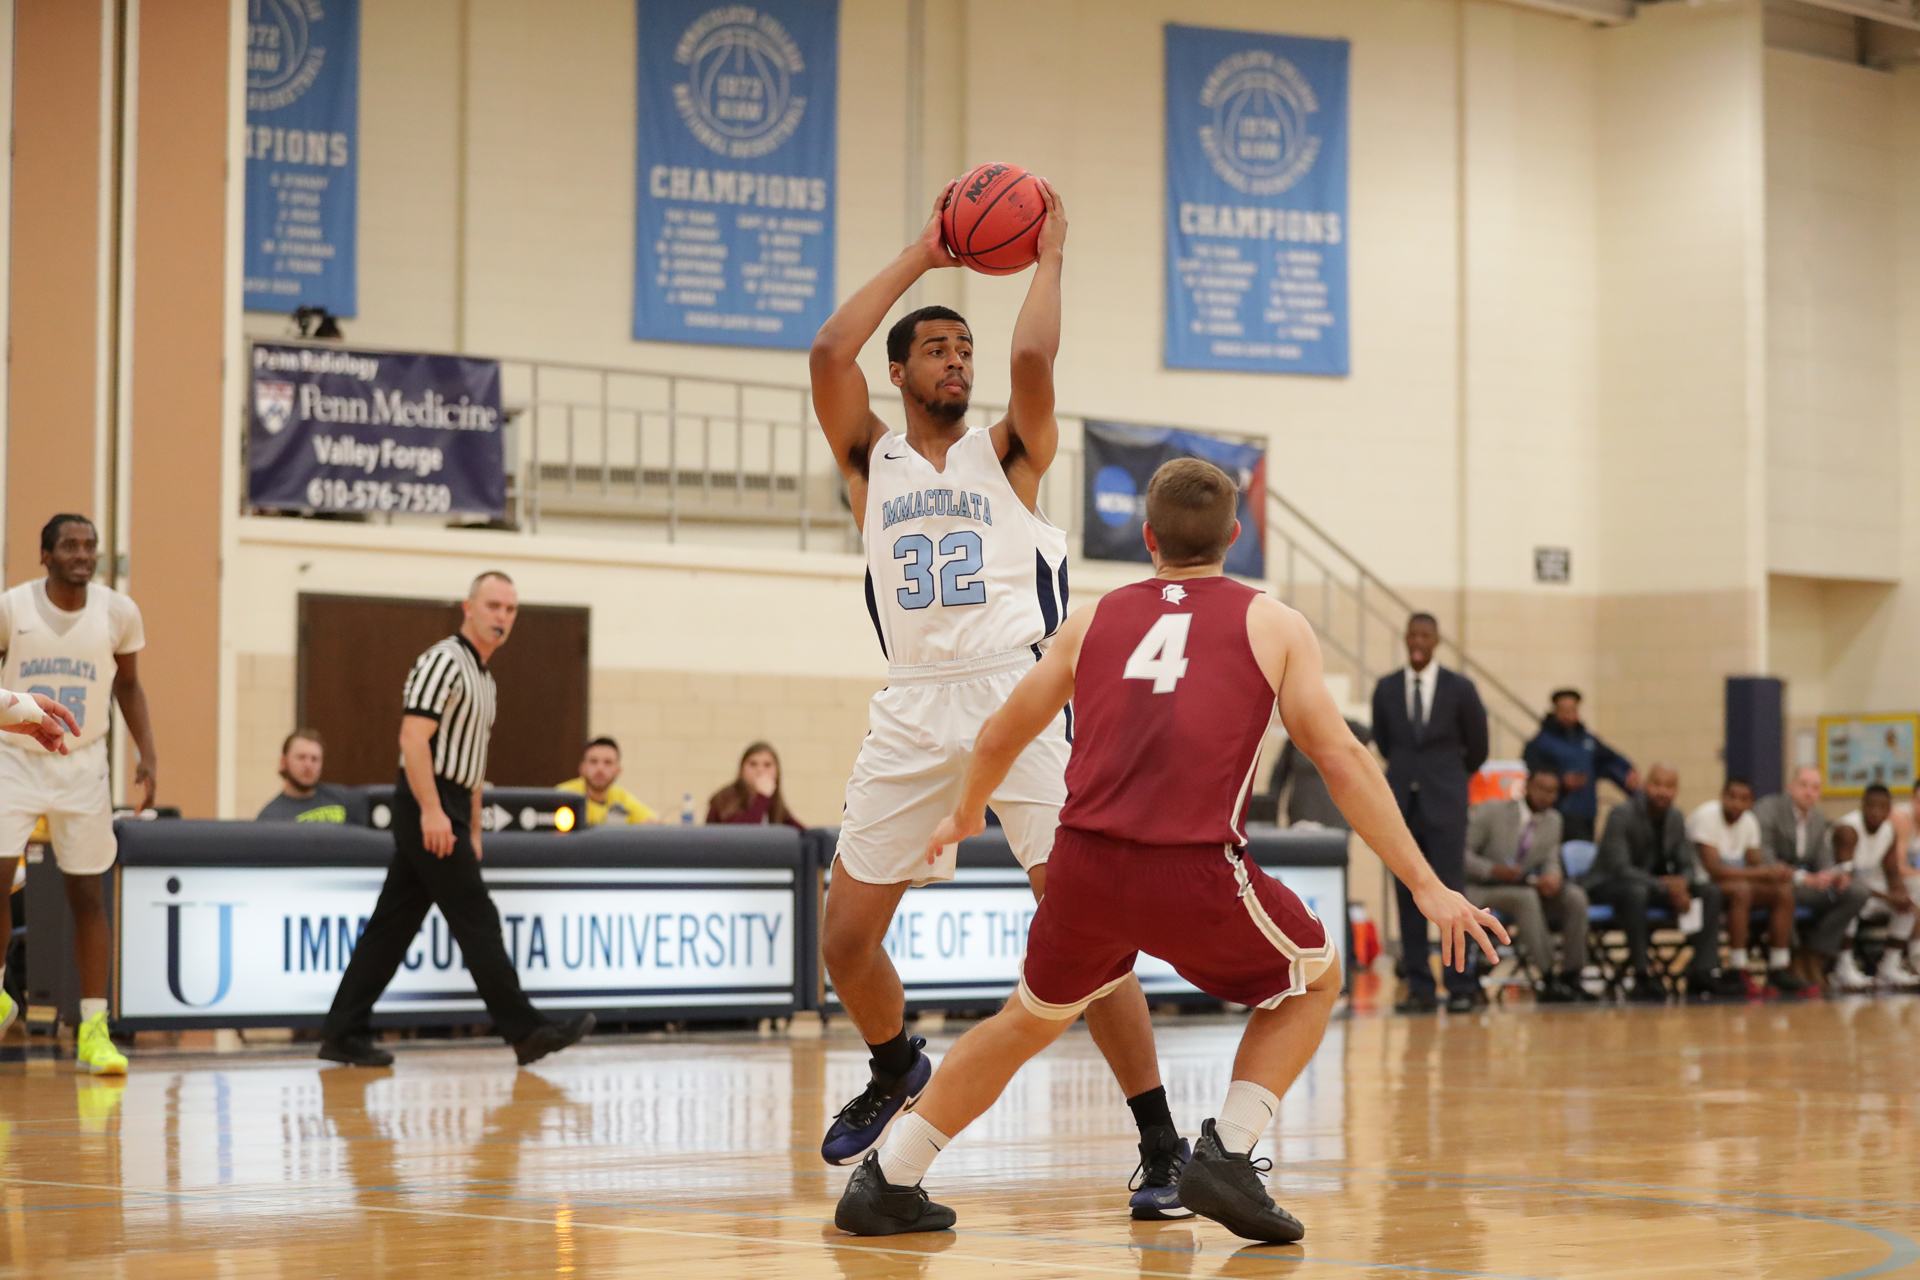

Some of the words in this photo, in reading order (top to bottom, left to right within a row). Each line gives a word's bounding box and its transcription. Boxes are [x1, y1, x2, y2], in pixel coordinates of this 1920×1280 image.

[650, 164, 826, 212] CHAMPIONS
[965, 164, 1009, 203] NCAA
[1179, 202, 1342, 245] CHAMPIONS
[254, 347, 298, 371] Penn
[300, 351, 379, 381] Radiology
[300, 383, 368, 424] Penn
[371, 387, 498, 432] Medicine
[313, 434, 379, 475] Valley
[380, 437, 444, 477] Forge
[882, 488, 993, 531] IMMACULATA
[893, 530, 987, 611] 32
[19, 656, 97, 682] IMMACULATA
[1122, 612, 1194, 695] 4
[28, 684, 86, 732] 5
[561, 911, 783, 970] UNIVERSITY
[937, 911, 975, 958] OF
